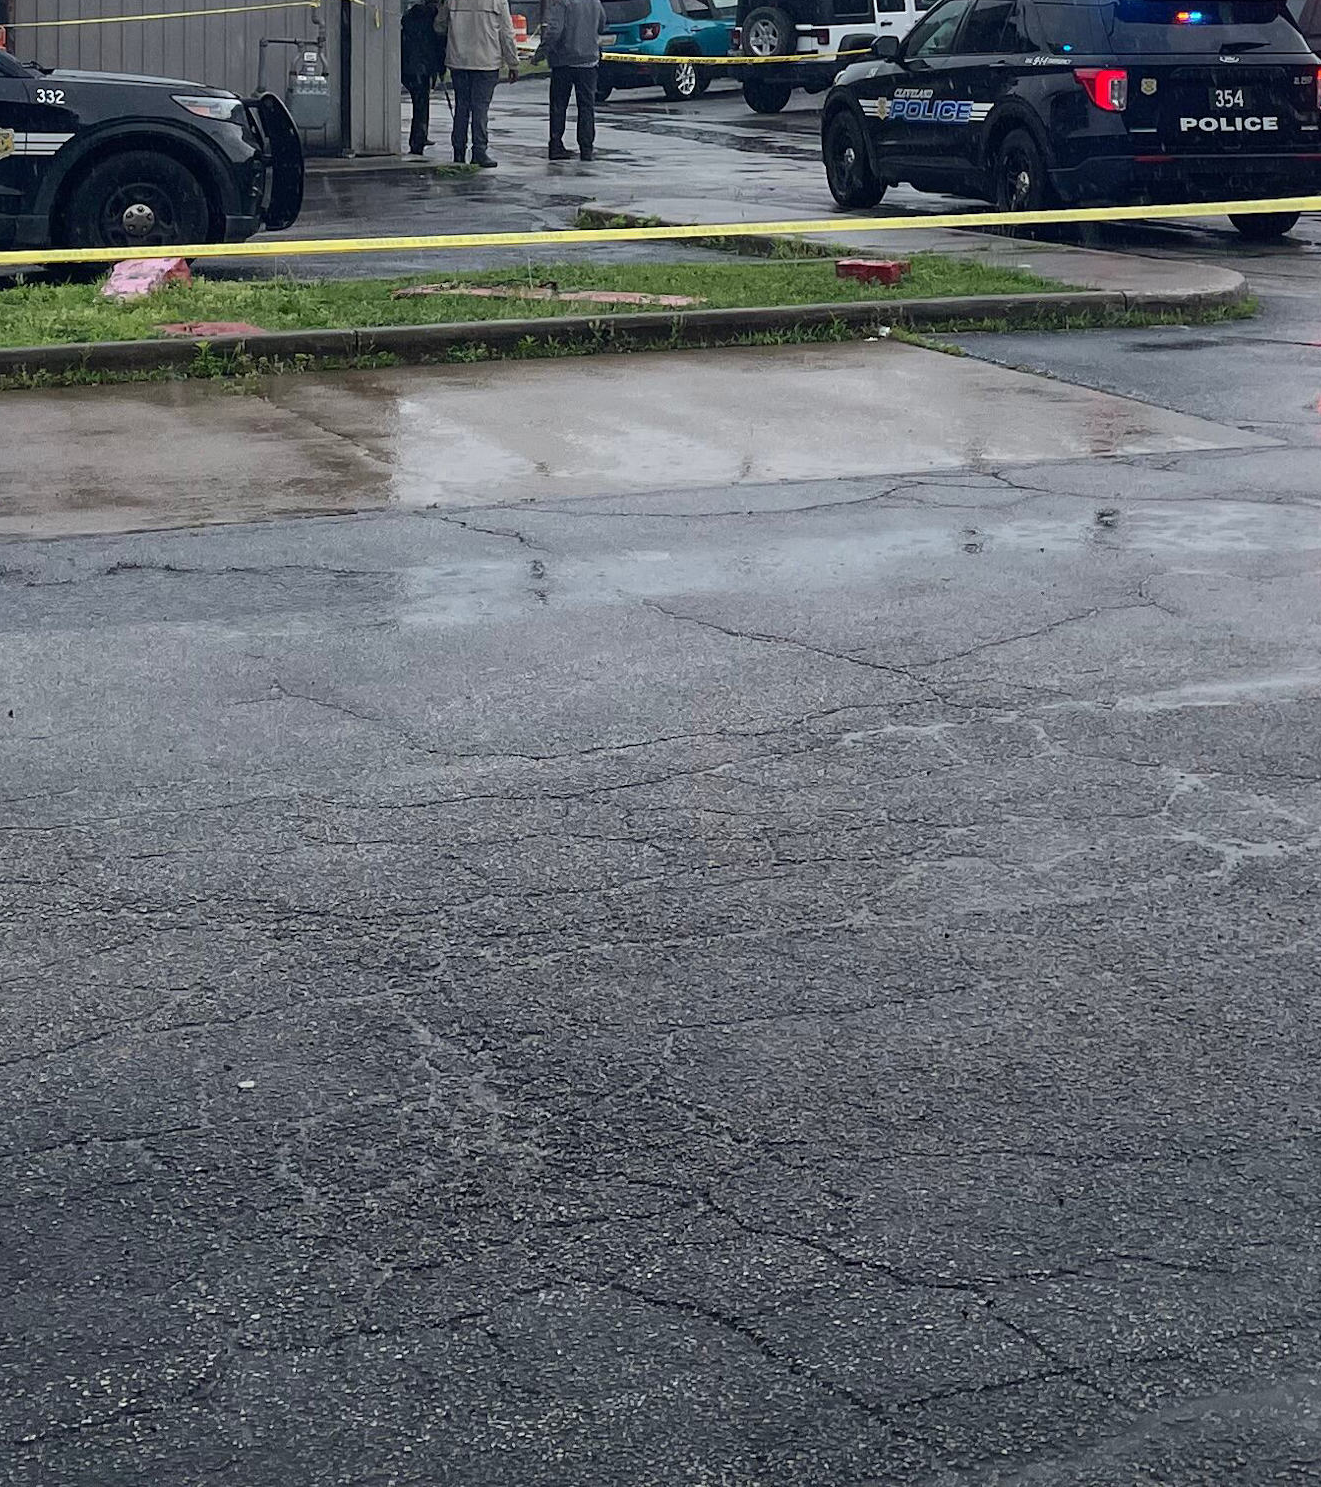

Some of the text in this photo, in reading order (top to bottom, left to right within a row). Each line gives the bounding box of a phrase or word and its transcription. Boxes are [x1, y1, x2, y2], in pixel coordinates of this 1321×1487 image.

[37, 88, 66, 104] 332
[1215, 89, 1244, 108] 354
[889, 99, 975, 122] POLICE
[1180, 116, 1278, 132] POLICE
